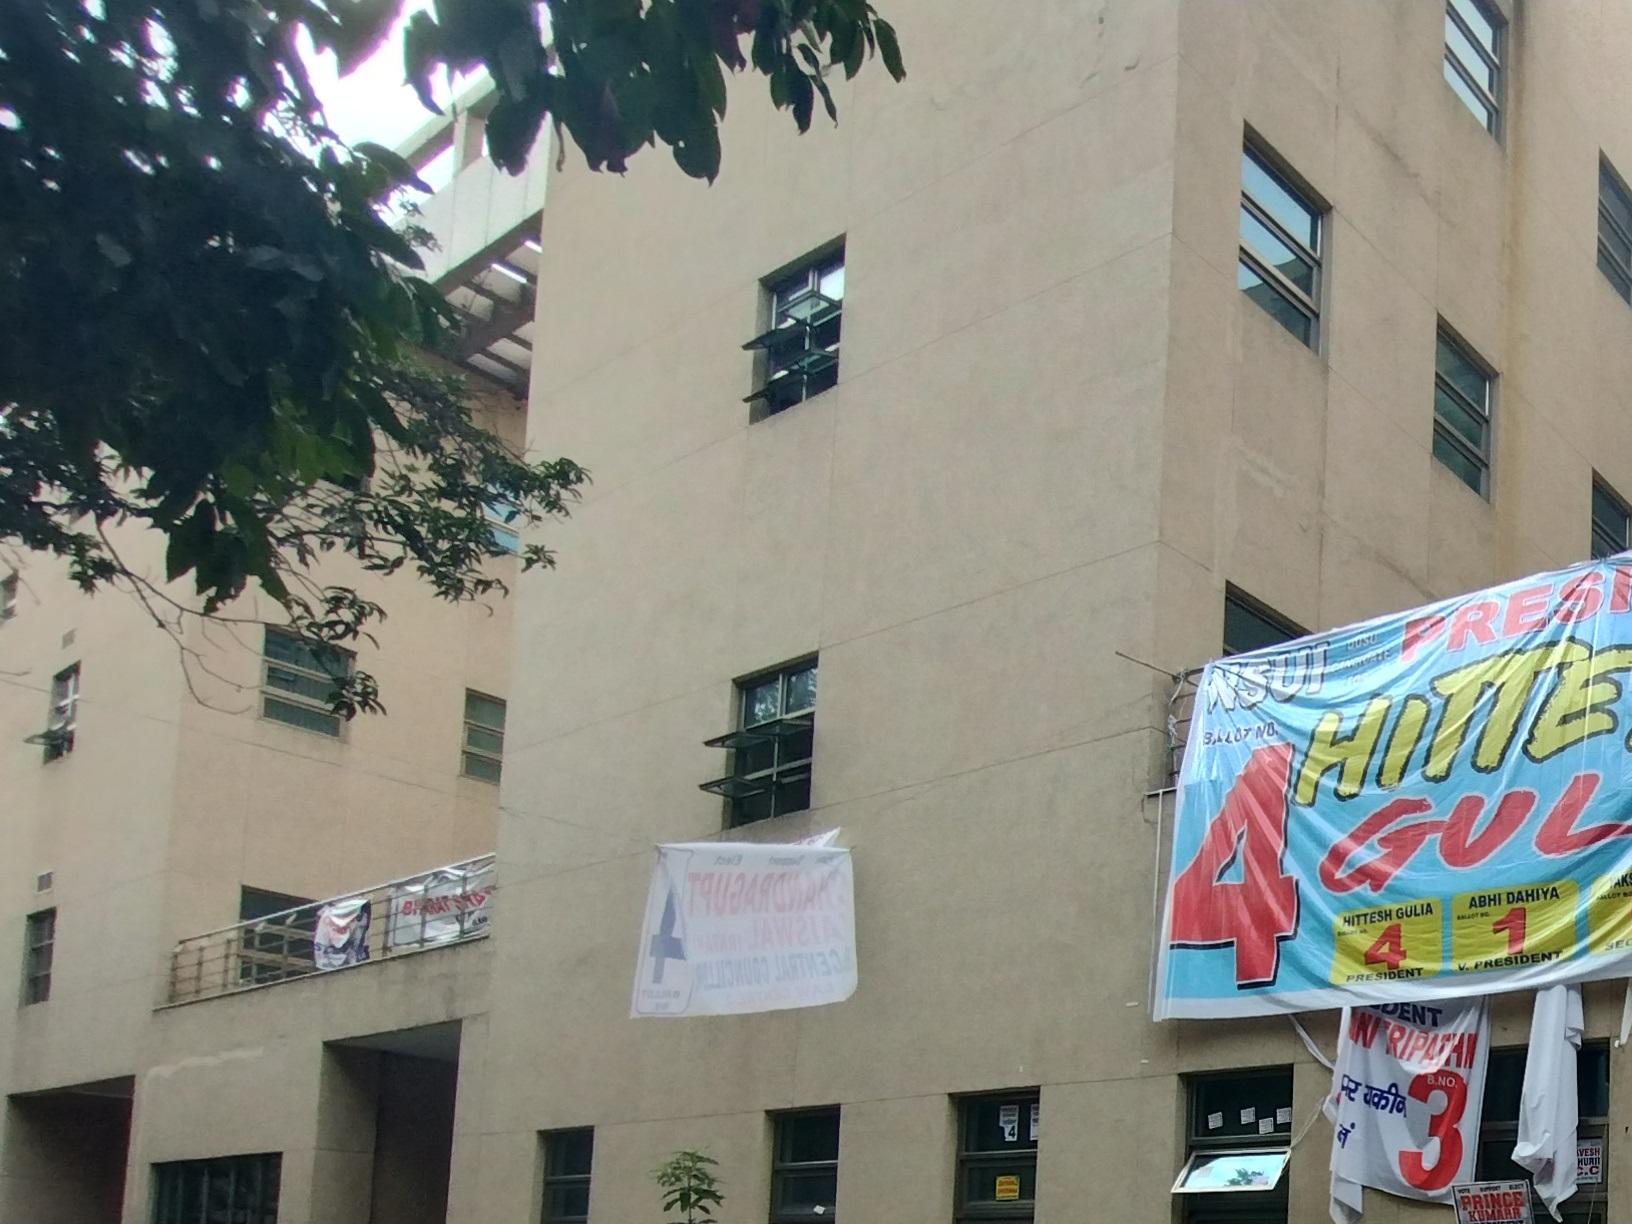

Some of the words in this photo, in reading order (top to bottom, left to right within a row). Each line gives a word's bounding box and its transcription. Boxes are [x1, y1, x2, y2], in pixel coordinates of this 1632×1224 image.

[1206, 640, 1332, 716] NSUI
[1203, 726, 1253, 746] BALLOT
[1254, 721, 1280, 738] NO.
[1166, 740, 1299, 991] 4
[1468, 892, 1502, 909] ABHI
[1506, 886, 1560, 905] DAHIYA
[1343, 907, 1393, 928] HITTESH
[1396, 902, 1434, 920] GULIA
[1492, 906, 1527, 956] 1
[1364, 922, 1408, 971] 4
[1457, 961, 1471, 972] V.
[1474, 950, 1563, 971] PRESIDENT
[1346, 967, 1424, 984] PRESIDENT
[1399, 1069, 1468, 1192] 3
[1460, 1191, 1525, 1212] PRINCE
